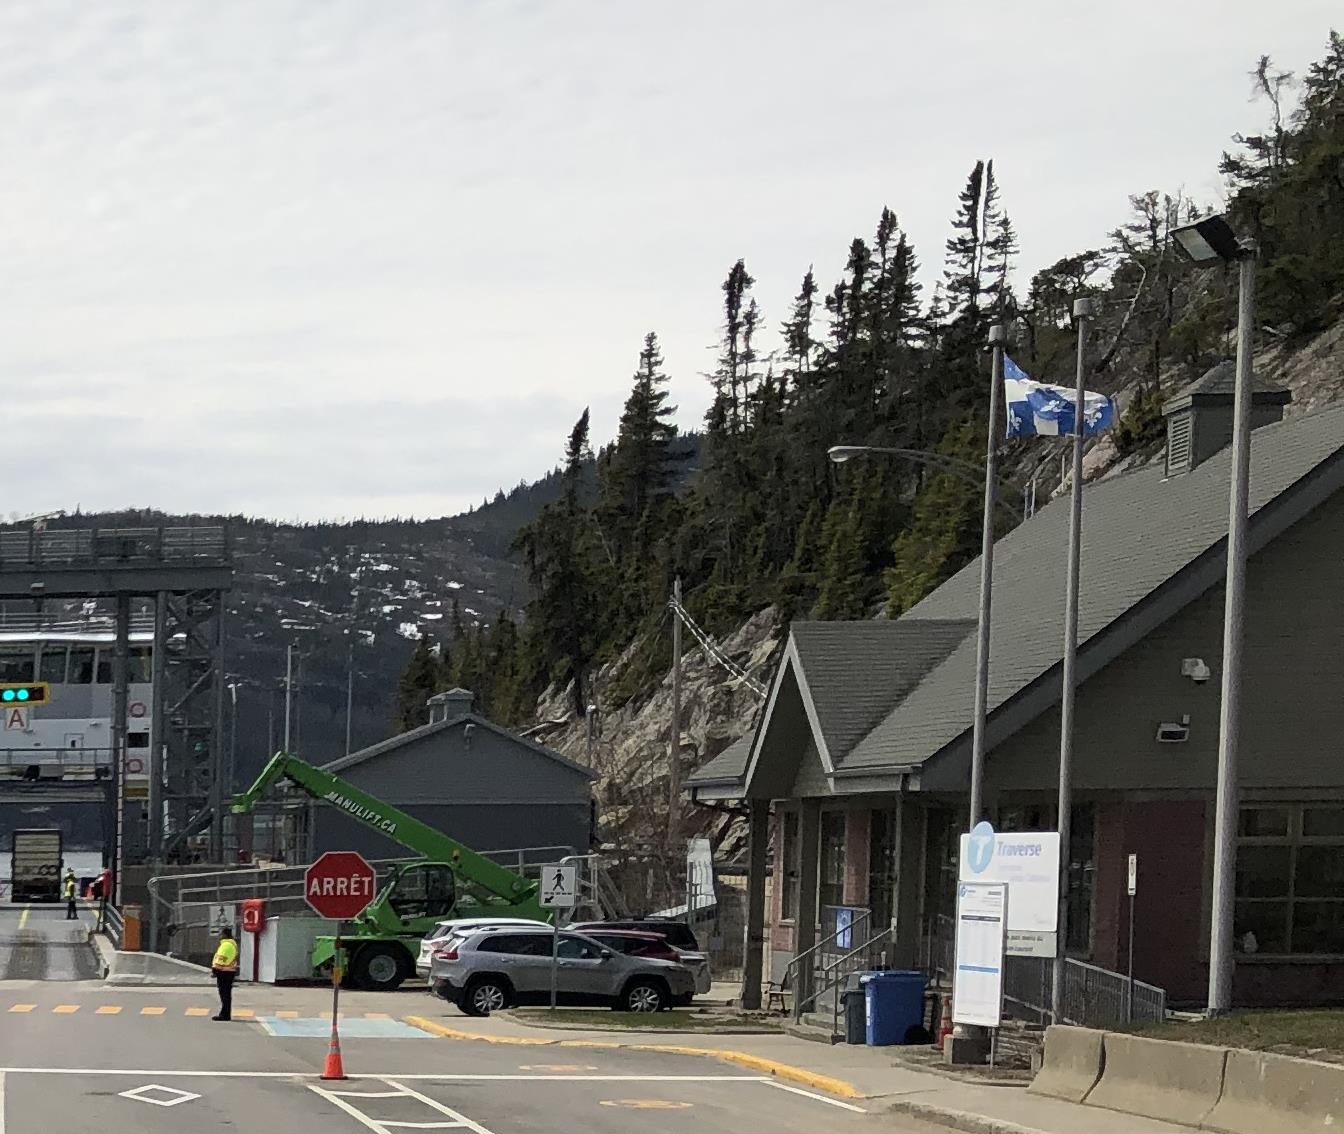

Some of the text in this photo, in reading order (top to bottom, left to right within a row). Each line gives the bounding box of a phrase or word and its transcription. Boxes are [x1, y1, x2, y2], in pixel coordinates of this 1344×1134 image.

[8, 709, 25, 728] A
[324, 791, 397, 834] MANULIFT.CA
[997, 841, 1041, 857] Traverse
[309, 873, 372, 896] ARRÊT
